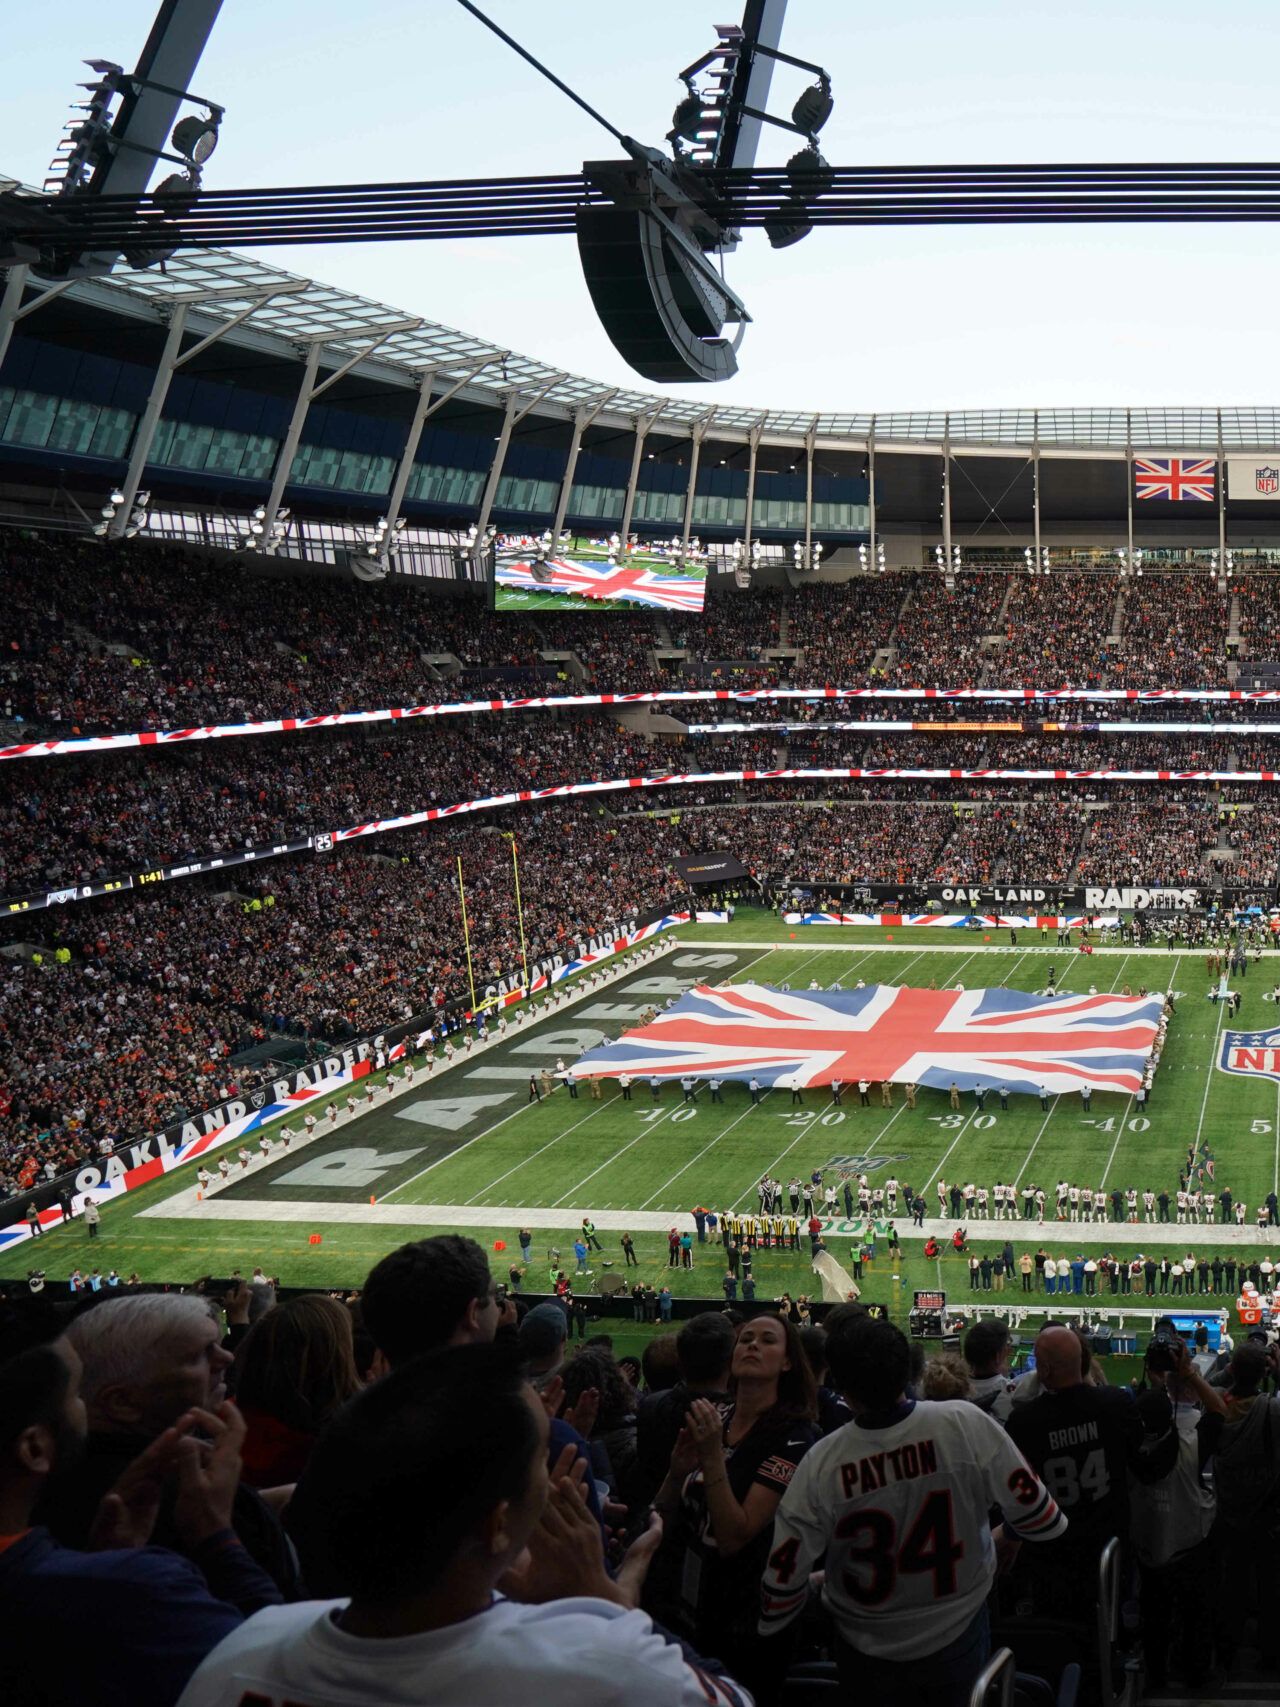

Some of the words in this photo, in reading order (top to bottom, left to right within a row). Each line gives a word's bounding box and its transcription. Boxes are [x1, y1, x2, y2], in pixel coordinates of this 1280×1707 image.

[1258, 478, 1277, 492] NFL
[316, 836, 332, 850] 25
[139, 870, 162, 885] 1:41
[687, 862, 728, 873] SUBWAY
[1085, 888, 1198, 910] RAIDERS
[485, 956, 564, 998] OAKLAND
[578, 921, 637, 957] RAIDERS
[984, 946, 1075, 954] LONDON
[269, 952, 738, 1187] RAIDERS
[75, 1101, 247, 1192] OAKLAND
[273, 1036, 385, 1101] RAIDERS
[1244, 1311, 1256, 1321] G
[1049, 1421, 1099, 1450] BROWN
[841, 1439, 938, 1500] PAYTON
[1043, 1448, 1112, 1507] 84
[834, 1488, 965, 1607] 34
